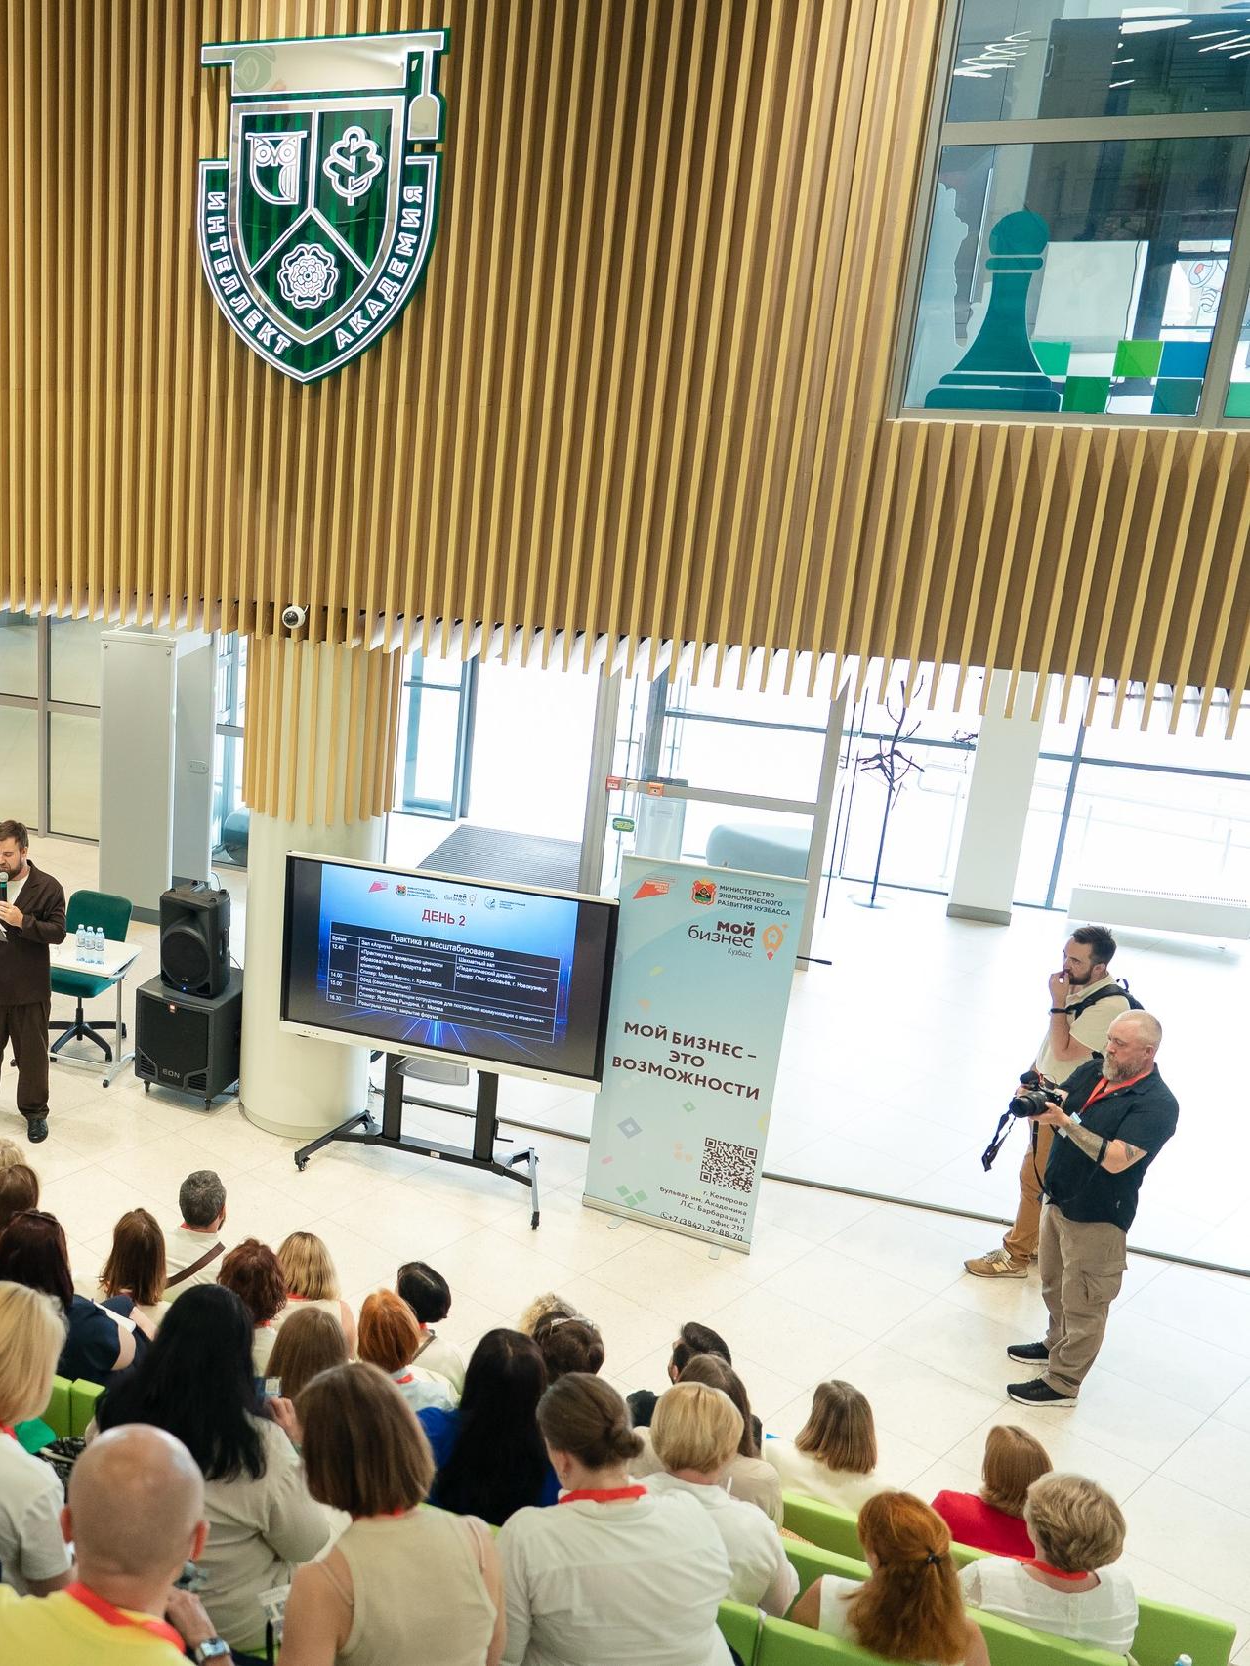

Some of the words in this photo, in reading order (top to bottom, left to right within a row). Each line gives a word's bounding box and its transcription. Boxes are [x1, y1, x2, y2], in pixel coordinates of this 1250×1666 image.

[206, 191, 291, 356] ИНТЕЛЛЕКТ
[334, 185, 423, 348] АКАДЕМИЯ
[719, 885, 775, 897] МИНИСТЕРСТВО
[717, 900, 752, 910] РАЗВИТИЯ
[754, 905, 791, 916] КУЗБАССА
[421, 909, 455, 925] ДЕНЬ
[459, 915, 466, 927] 2
[688, 924, 754, 949] бизнес
[716, 921, 756, 937] мой
[391, 934, 422, 946] Практика
[430, 942, 495, 958] масштабирование
[624, 1022, 668, 1041] МОЙ
[672, 1032, 744, 1059] БИЗНЕС
[668, 1050, 705, 1067] ЭТО
[612, 1056, 760, 1100] ВОЗМОЖНОСТИ
[659, 1186, 690, 1200] бульвар
[709, 1191, 748, 1208] Кемерово
